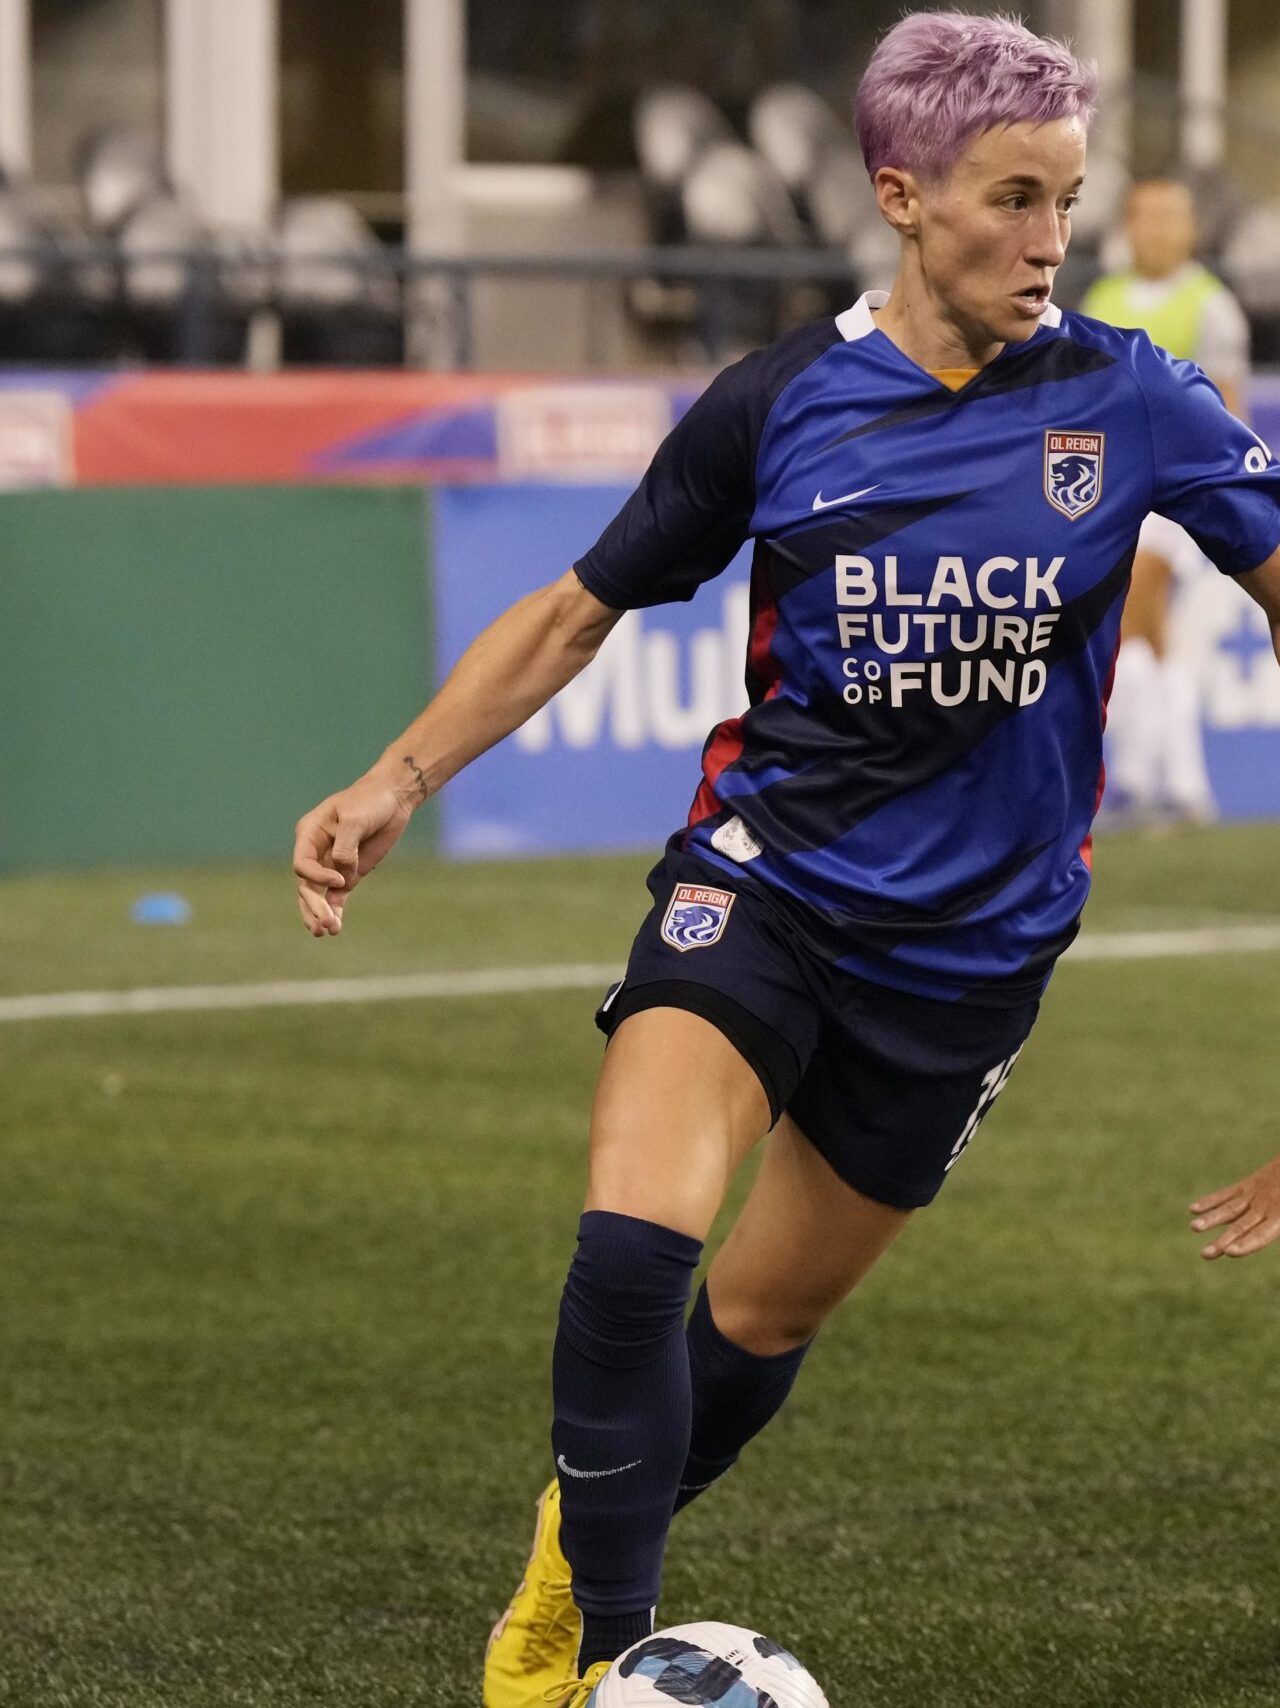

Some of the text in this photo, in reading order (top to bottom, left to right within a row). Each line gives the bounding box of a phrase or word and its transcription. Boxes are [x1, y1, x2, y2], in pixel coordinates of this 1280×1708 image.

[1050, 436, 1098, 452] OL REIGN
[835, 555, 1066, 609] BLACK
[837, 613, 1060, 655] FUTURE
[842, 657, 881, 681] CO
[843, 683, 882, 704] OP
[890, 658, 1047, 708] FUND
[678, 889, 729, 907] OL REIGN
